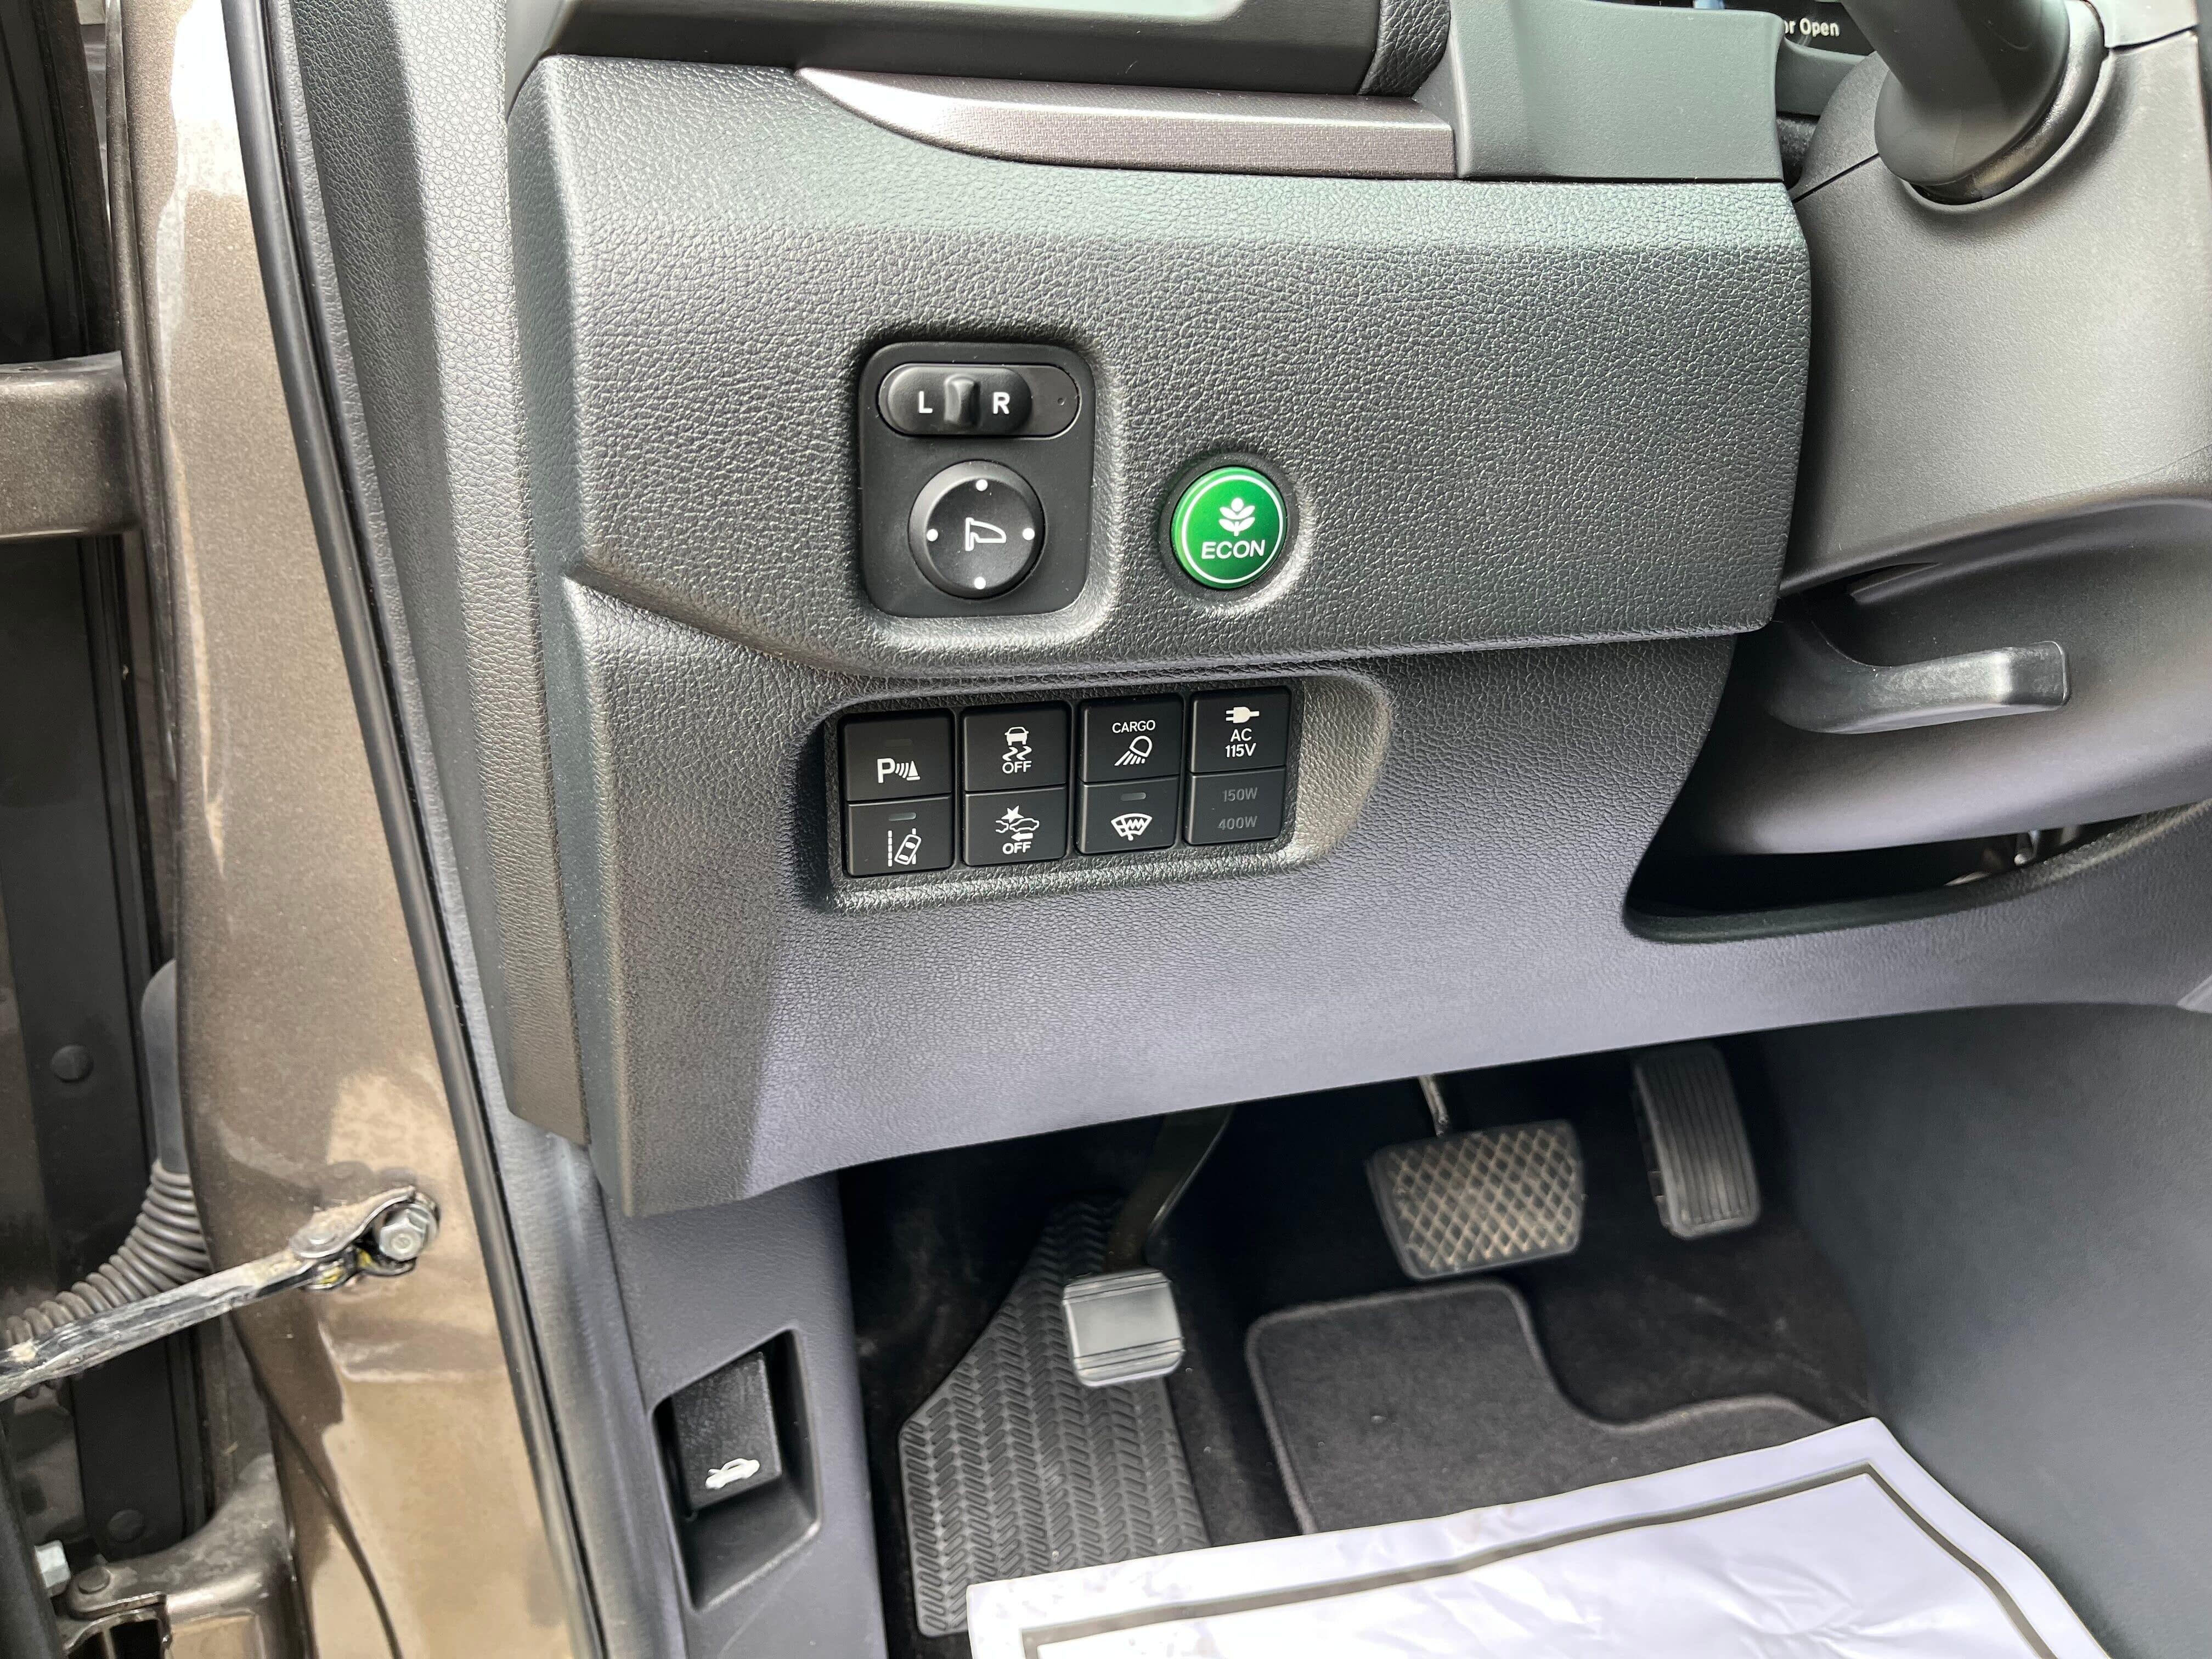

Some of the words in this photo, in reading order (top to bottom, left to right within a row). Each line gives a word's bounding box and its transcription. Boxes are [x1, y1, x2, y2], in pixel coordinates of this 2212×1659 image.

[1799, 18, 1840, 37] Open
[918, 390, 933, 414] L
[992, 391, 1011, 414] R
[1201, 539, 1265, 560] ECON
[1112, 720, 1156, 733] CARGO
[1230, 728, 1252, 742] AC
[1224, 742, 1256, 758] 115V
[877, 758, 895, 783] P
[1002, 760, 1032, 774] OFF
[1222, 787, 1258, 803] 150W
[1217, 815, 1258, 831] 400W
[1002, 841, 1032, 855] OFF
